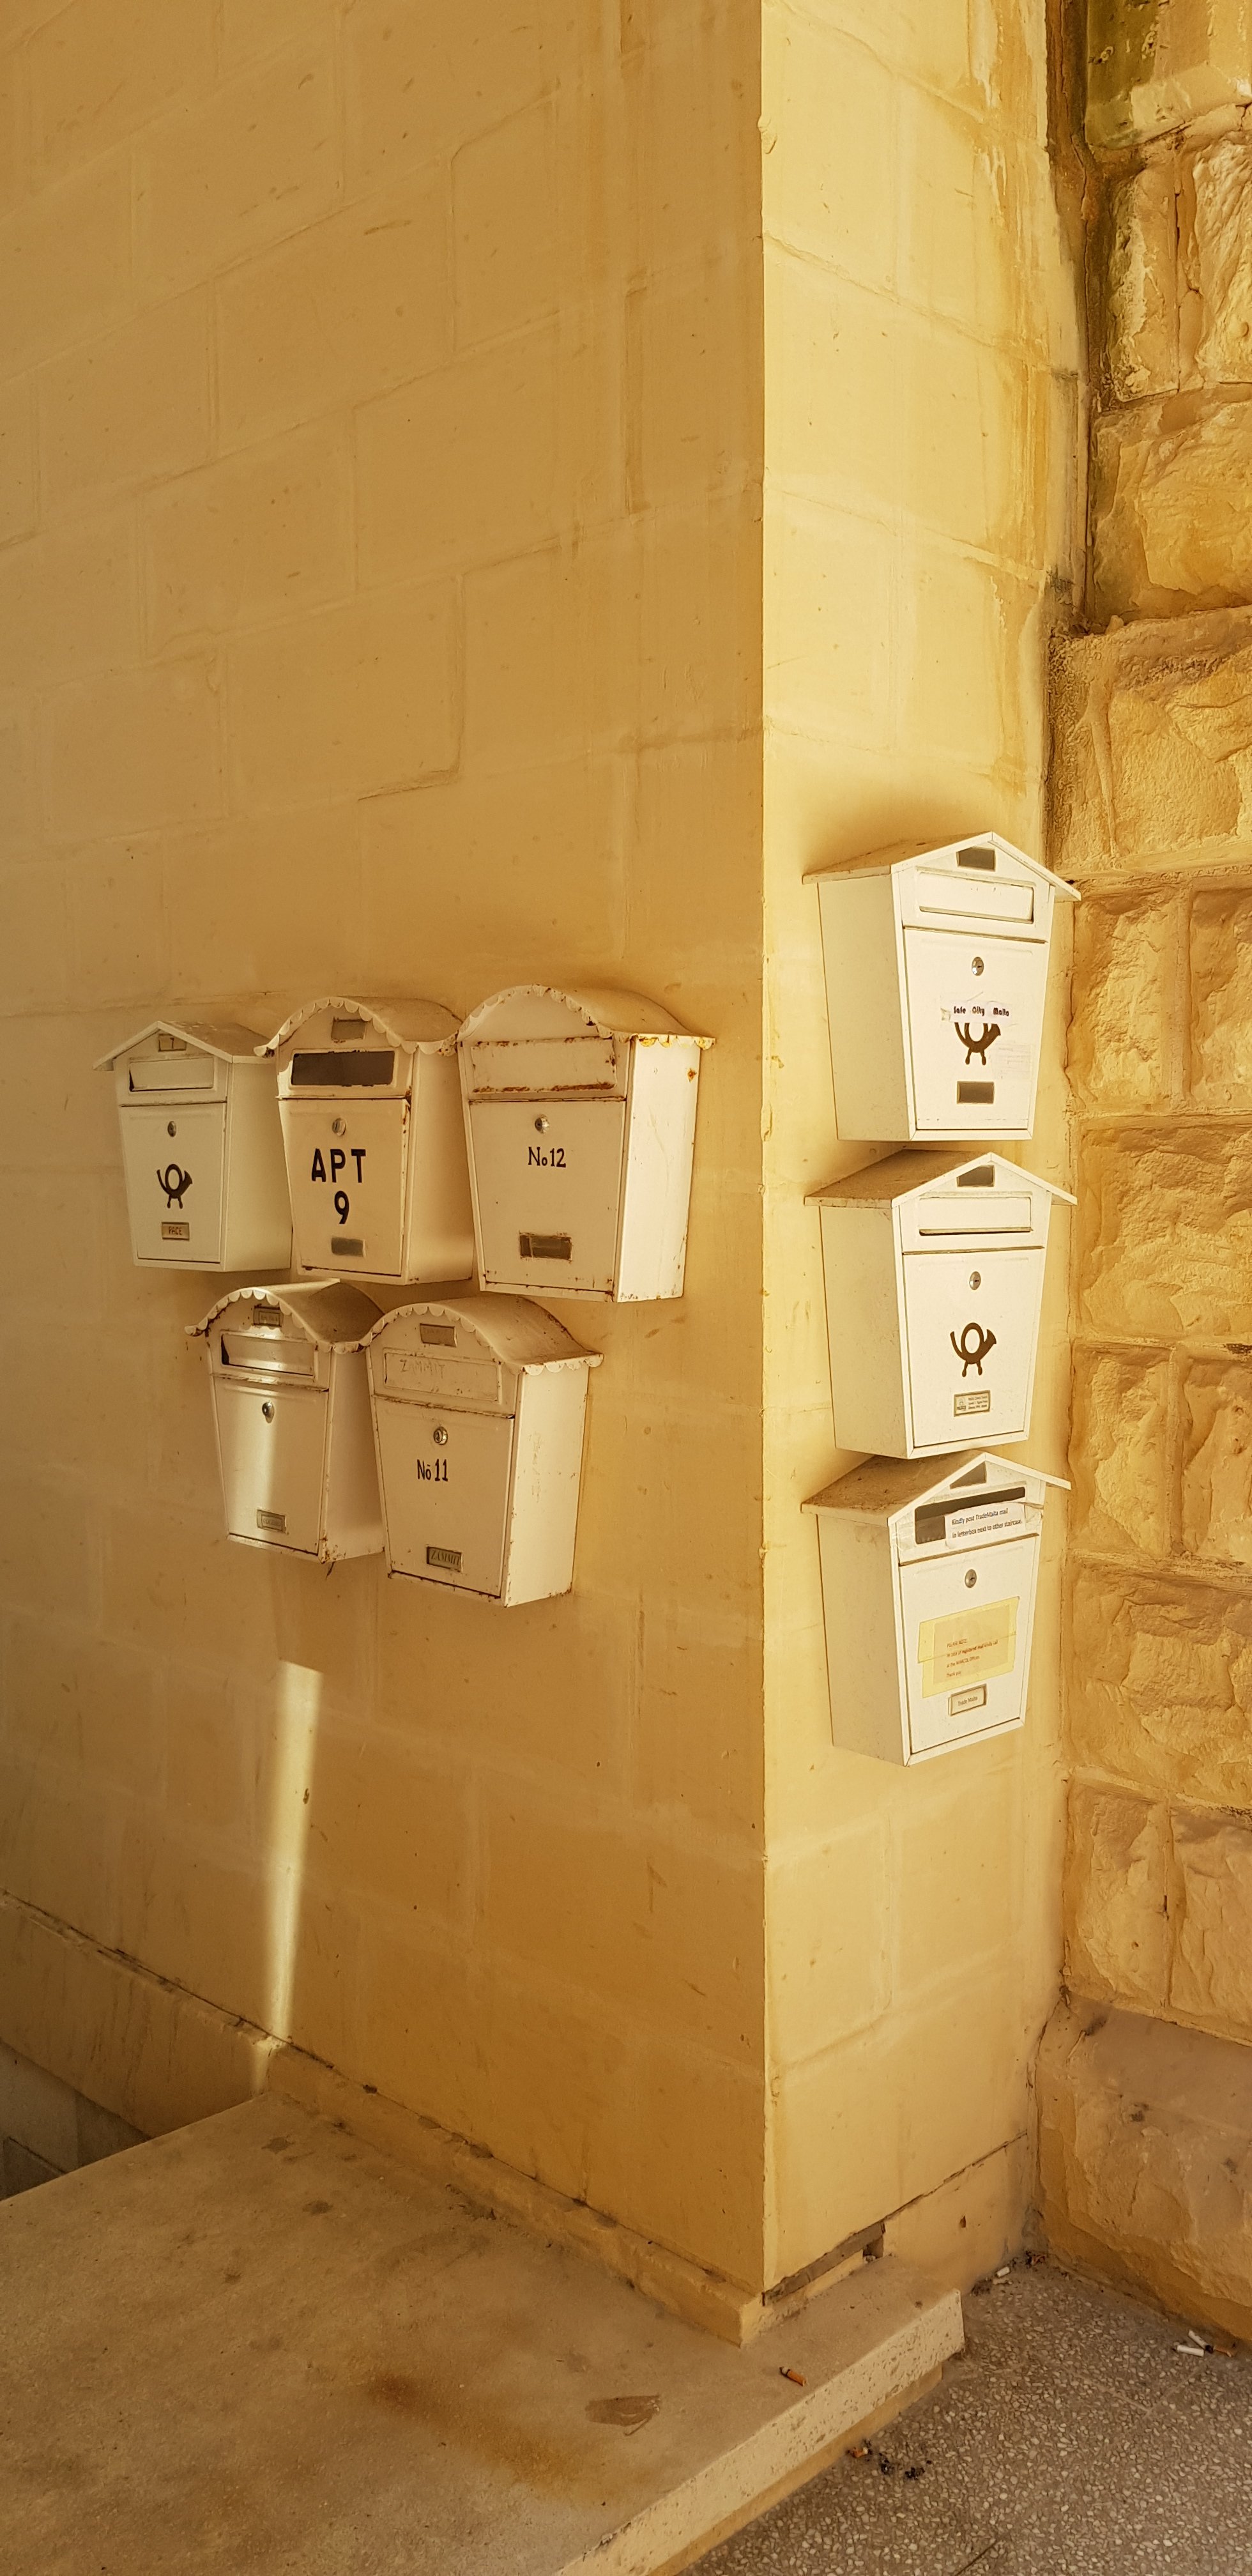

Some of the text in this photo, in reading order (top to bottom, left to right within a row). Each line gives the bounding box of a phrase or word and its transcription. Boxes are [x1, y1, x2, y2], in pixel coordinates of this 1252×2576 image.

[311, 1148, 366, 1183] APT
[334, 1190, 349, 1225] 9
[951, 1517, 965, 1526] Kindly
[965, 1515, 975, 1524] post
